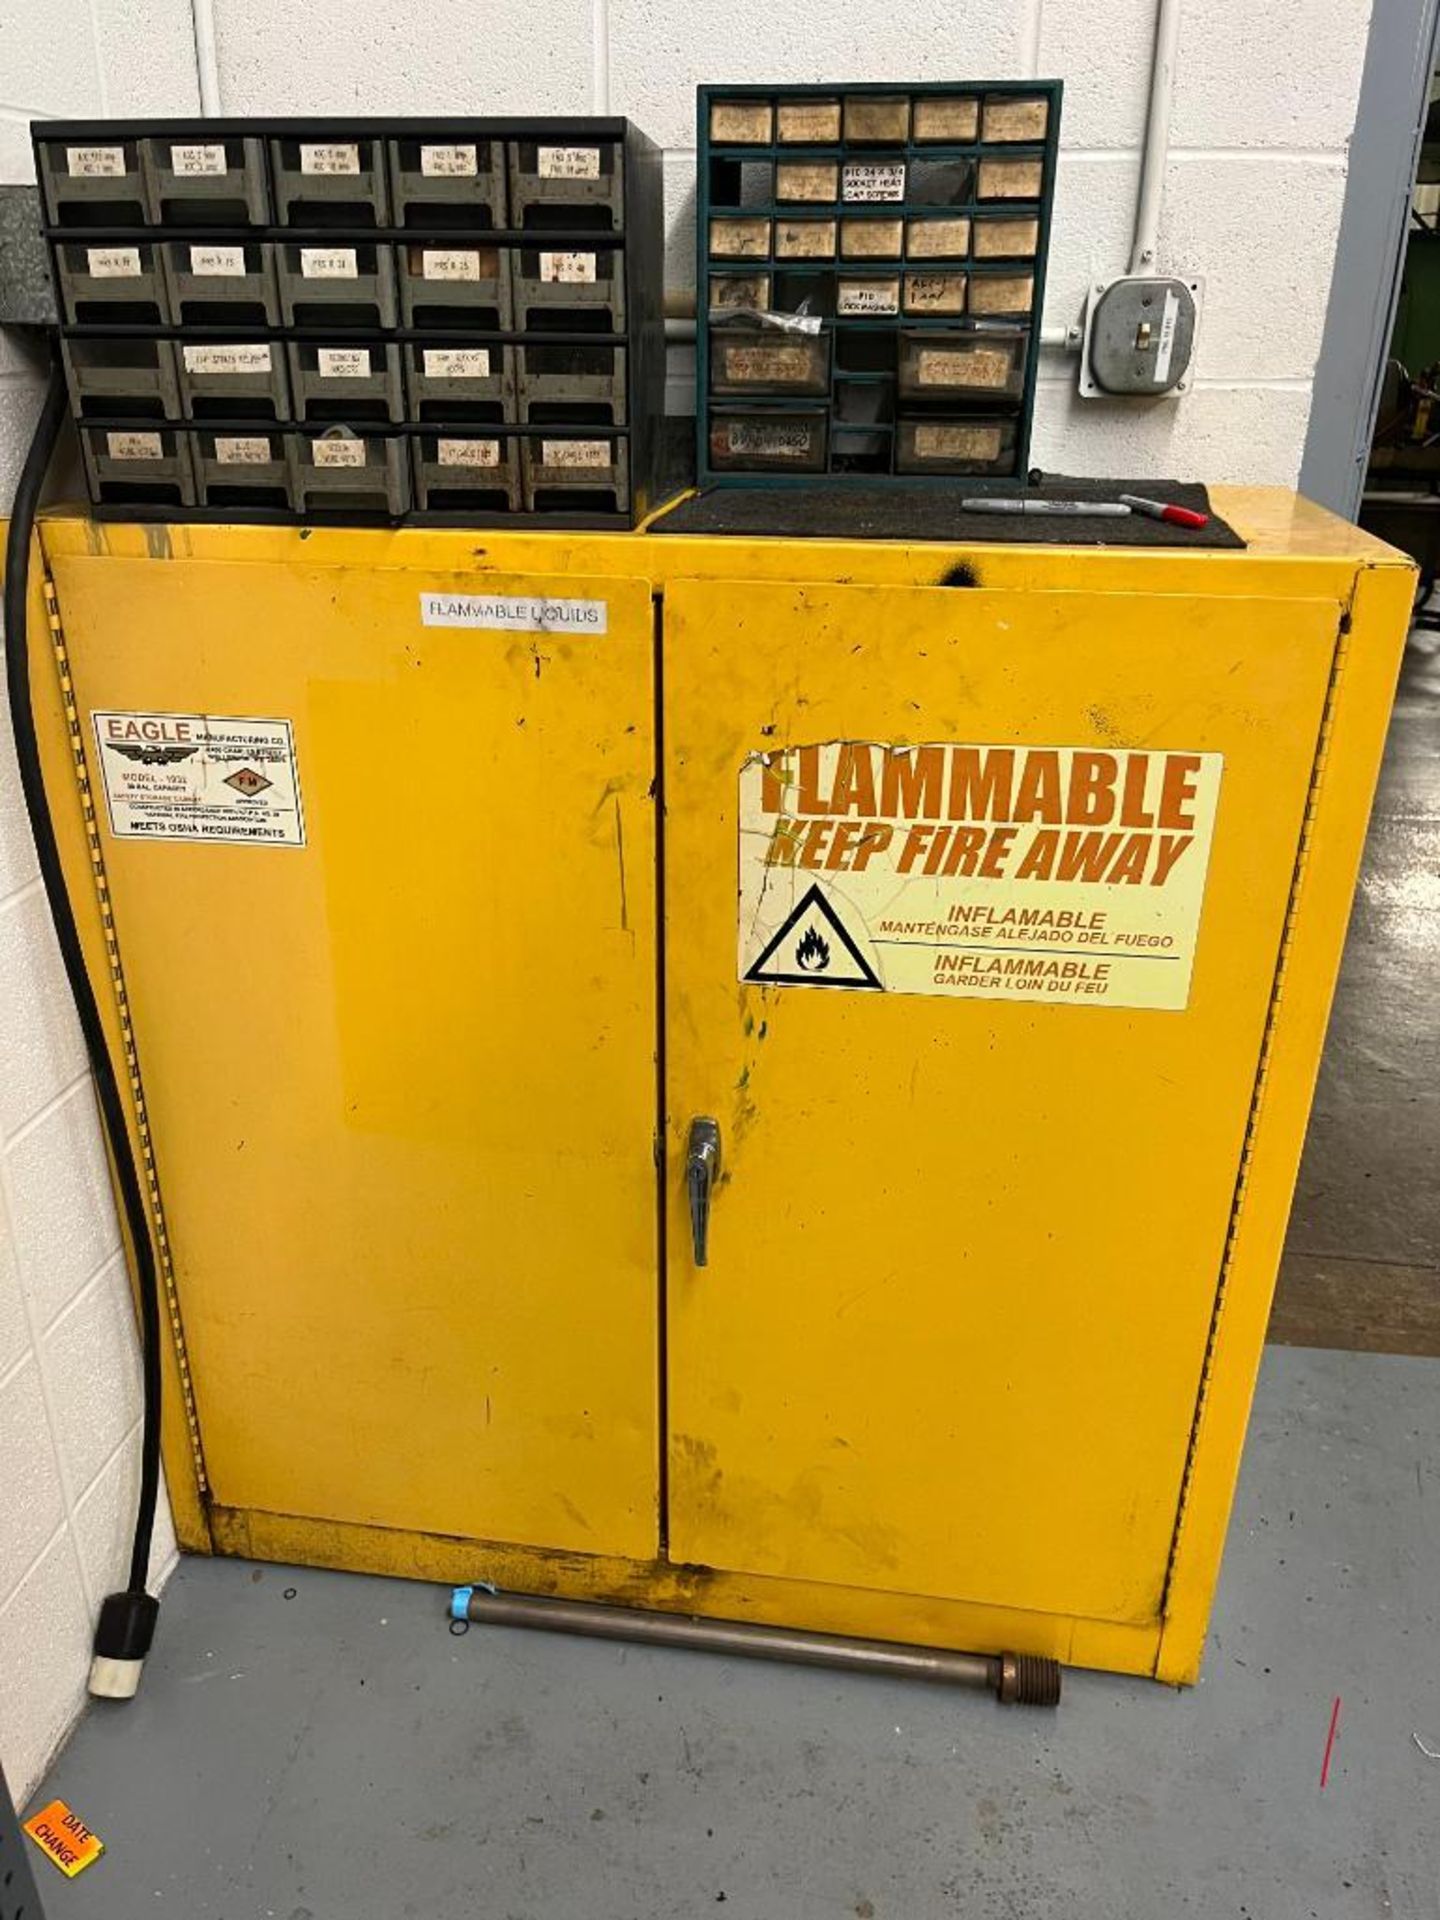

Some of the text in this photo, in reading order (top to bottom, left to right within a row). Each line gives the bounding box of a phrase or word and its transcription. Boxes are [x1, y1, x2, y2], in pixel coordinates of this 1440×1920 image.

[429, 600, 599, 624] FLAMMABLE LIQUIDS
[107, 719, 192, 741] EAGLE
[761, 744, 1201, 830] FLAMMABLE
[130, 821, 166, 831] MEETS
[201, 825, 286, 838] REQUIREMENTS
[764, 818, 1195, 887] KEEP FIRE AWAY
[948, 904, 1107, 930] INFLAMABLE
[996, 927, 1074, 943] ALEJADO
[1077, 931, 1110, 945] DEL
[1113, 934, 1174, 949] FUEGO
[934, 953, 1111, 981] INFLAMMABLE
[933, 975, 1109, 994] GARDER LOIN DU FEU
[61, 1814, 91, 1844] DATE
[34, 1823, 79, 1868] CHANGE
